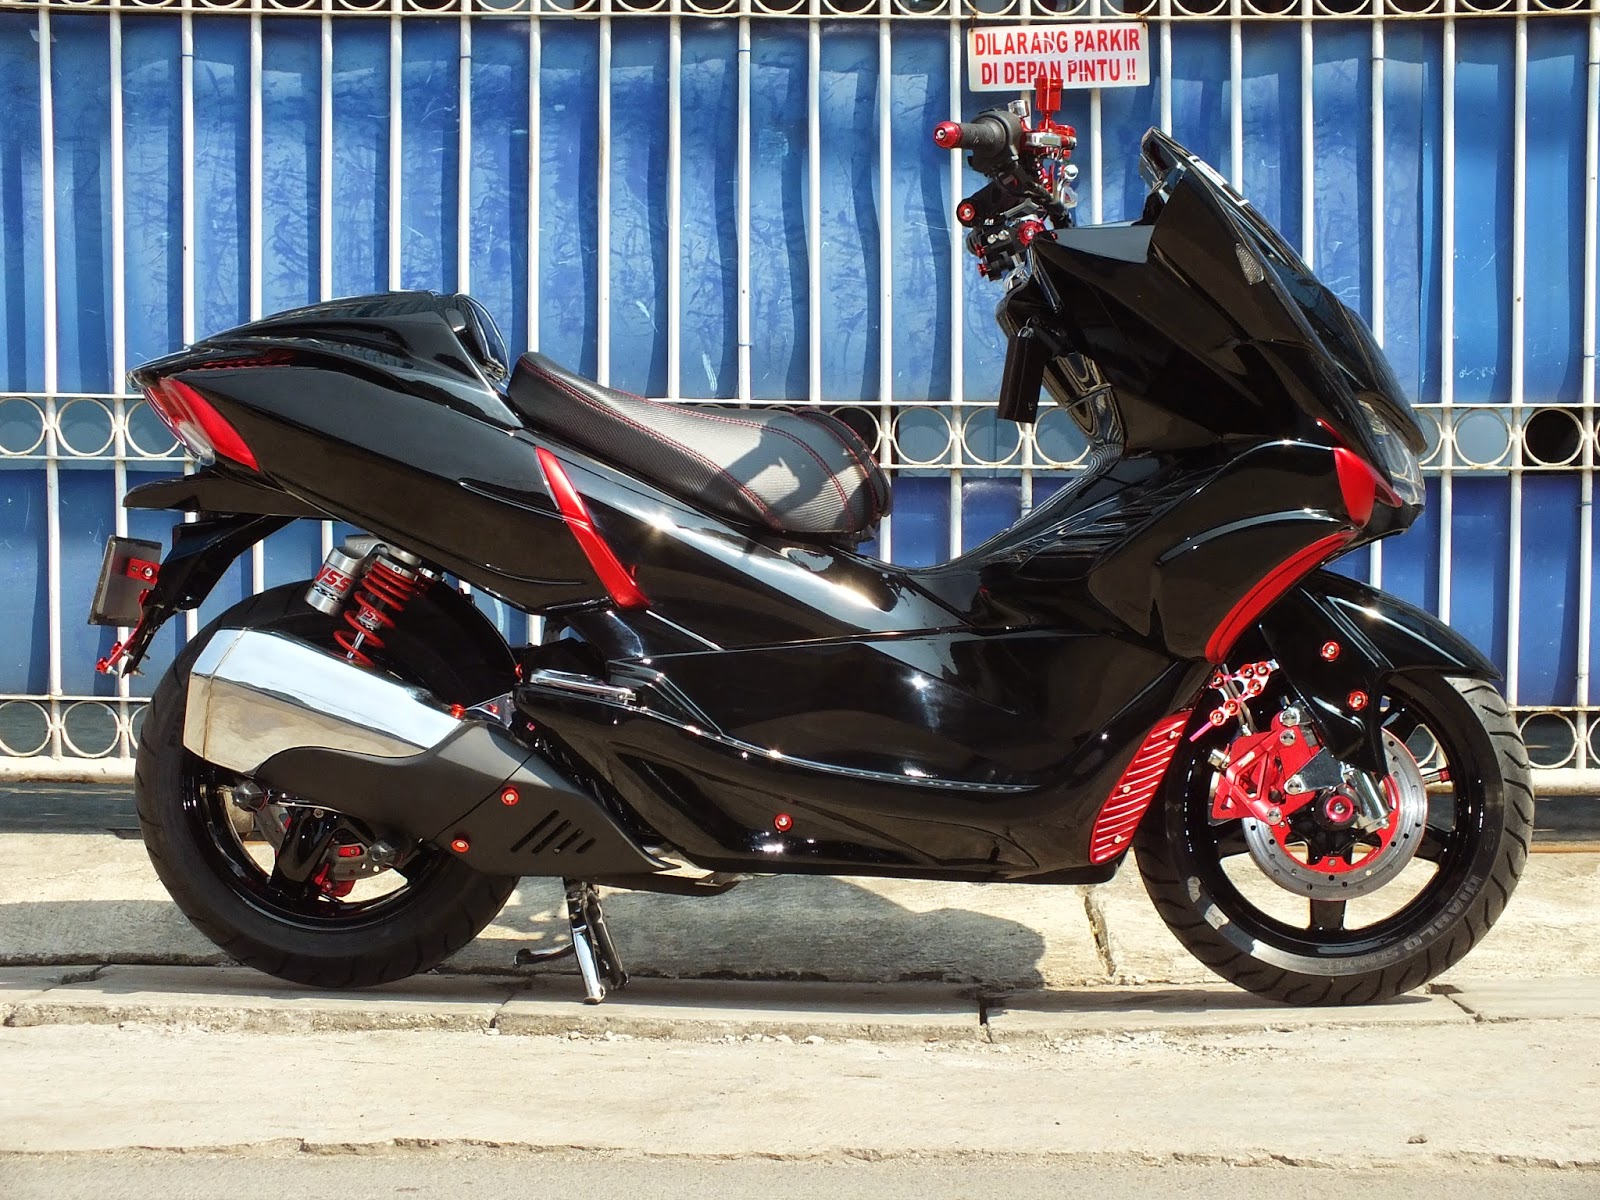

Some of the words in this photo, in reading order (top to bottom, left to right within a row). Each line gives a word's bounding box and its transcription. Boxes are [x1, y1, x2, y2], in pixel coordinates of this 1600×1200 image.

[975, 30, 1068, 56] DILARANG
[1075, 28, 1141, 52] PARKIR
[981, 62, 998, 85] DI
[1004, 60, 1061, 84] DEPAN
[1067, 58, 1120, 82] PINTU
[314, 563, 353, 592] YSS
[1402, 874, 1482, 951] DIABLO
